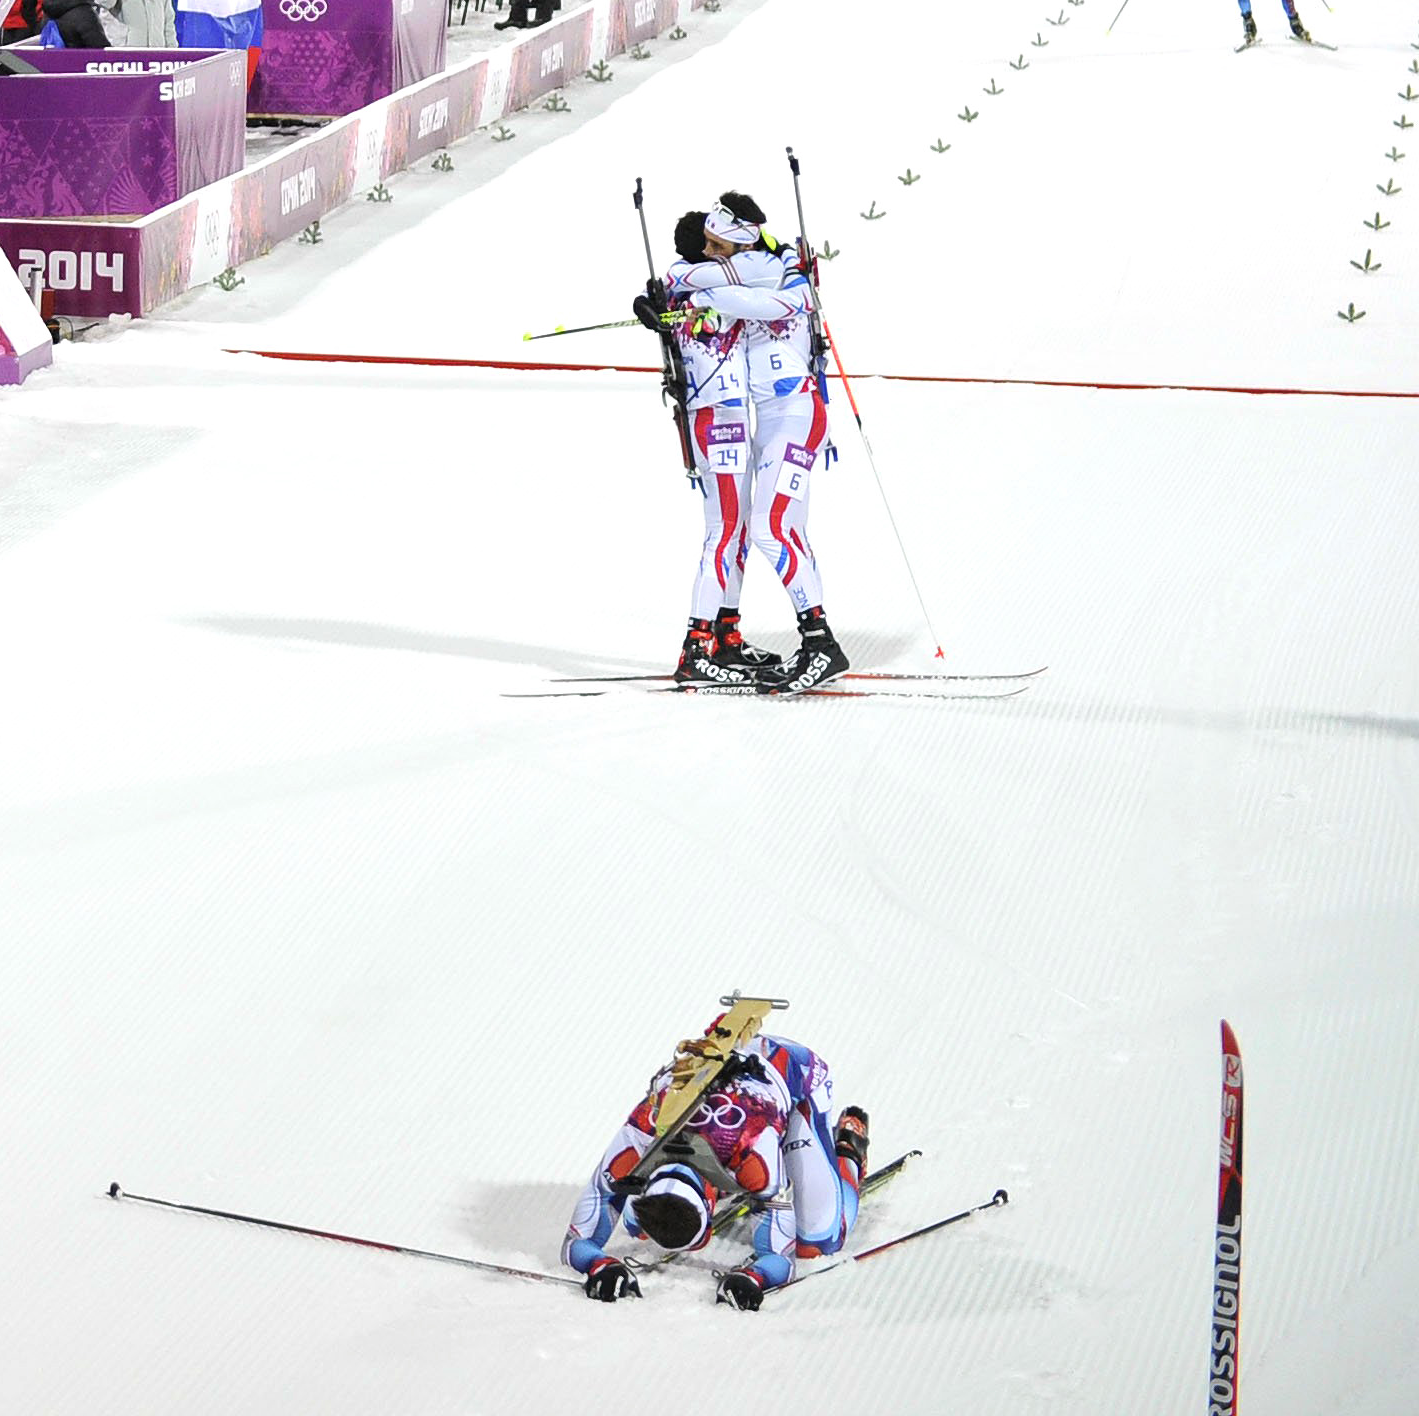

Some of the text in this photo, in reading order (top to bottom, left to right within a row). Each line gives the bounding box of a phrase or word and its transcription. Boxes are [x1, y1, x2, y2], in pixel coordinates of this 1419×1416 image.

[19, 248, 124, 292] 2014
[770, 354, 782, 370] 6
[716, 374, 740, 392] 14
[717, 449, 738, 466] 14
[790, 472, 802, 491] 6
[695, 658, 746, 683] ROSSI
[788, 651, 832, 692] ROSSI
